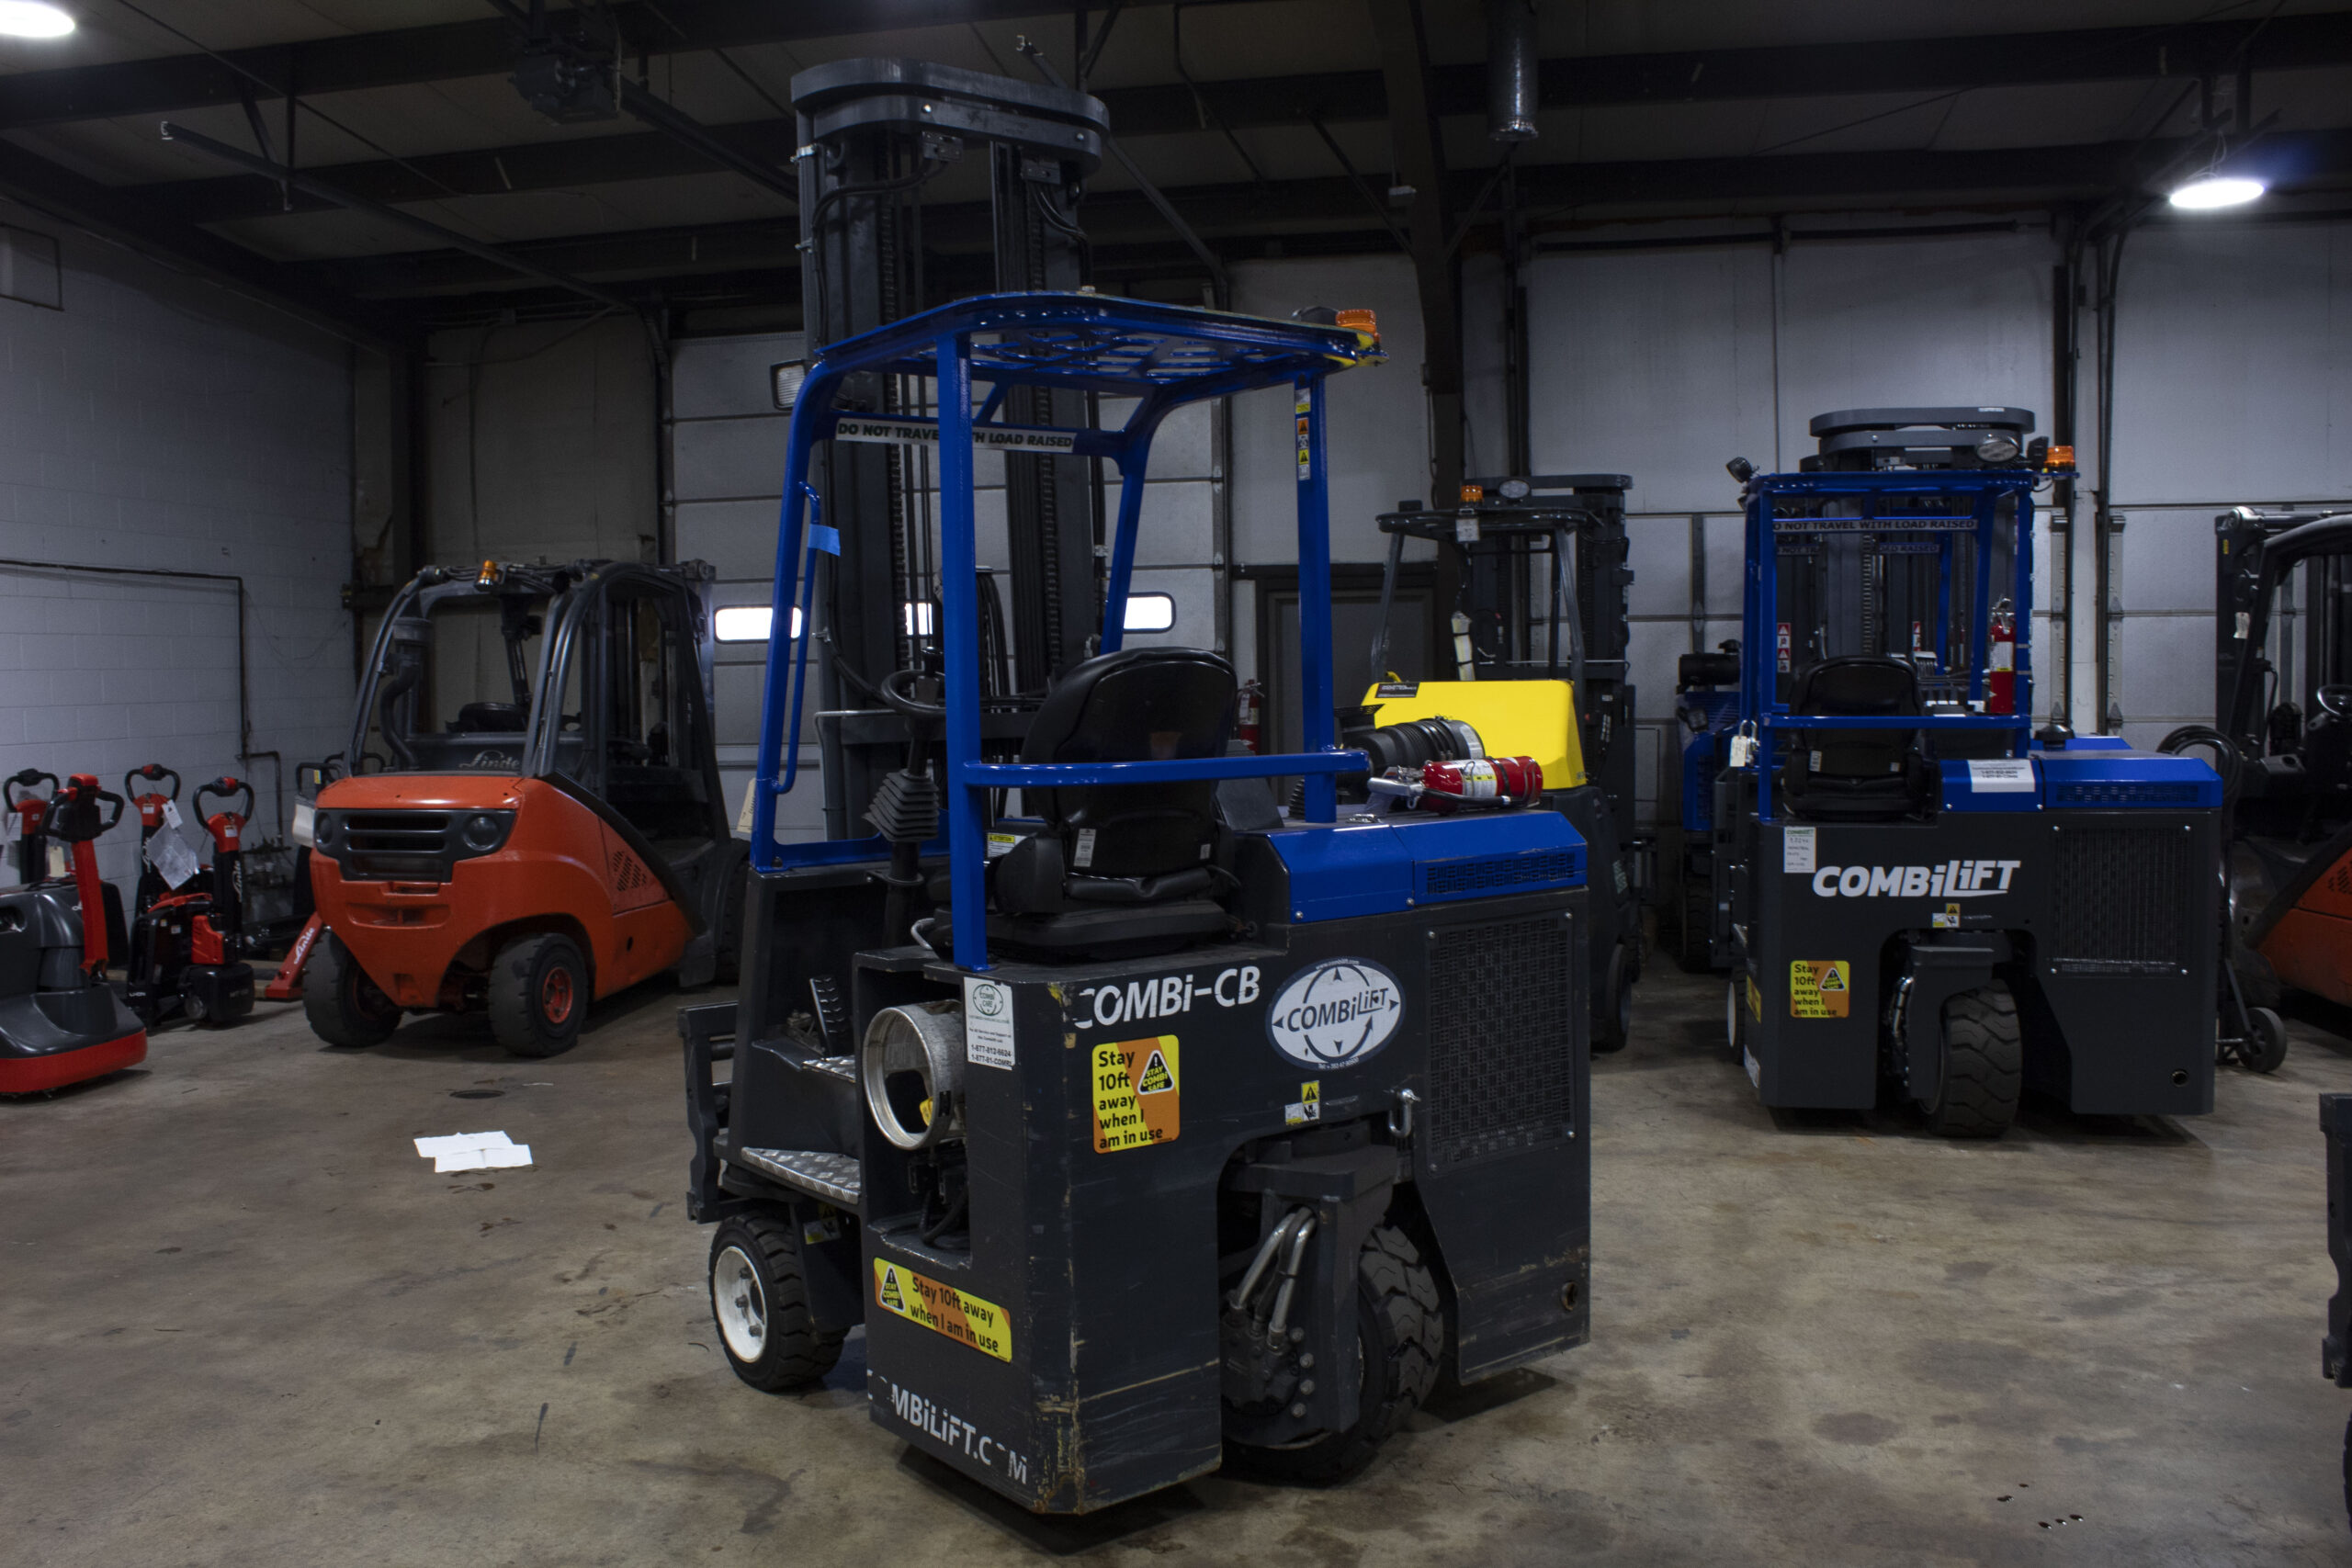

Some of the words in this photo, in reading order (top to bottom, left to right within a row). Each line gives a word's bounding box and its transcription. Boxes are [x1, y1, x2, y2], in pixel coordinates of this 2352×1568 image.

[838, 423, 858, 434] DO
[864, 424, 890, 437] NOT
[896, 426, 939, 440] TRAVE
[989, 433, 1023, 445] LOAD
[1027, 435, 1071, 447] RAISED
[1785, 522, 1807, 530] NOT
[1813, 521, 1855, 530] TRAVEL
[1859, 521, 1891, 529] WITH
[1894, 520, 1926, 529] LOAD
[1930, 520, 1974, 528] RAISED
[459, 750, 520, 768] Linde
[1794, 964, 1820, 976] Stay
[1794, 976, 1815, 986] 10ft
[1794, 988, 1819, 997] away
[1794, 998, 1819, 1006] when
[1099, 1051, 1136, 1068] Stay
[1146, 1066, 1163, 1077] STAY
[1099, 1071, 1130, 1091] 10ft
[1147, 1081, 1166, 1092] SAFE
[1099, 1095, 1136, 1111] away
[1099, 1113, 1136, 1130] when
[1140, 1109, 1144, 1122] I
[1100, 1135, 1120, 1149] am
[1124, 1130, 1136, 1145] in
[1140, 1128, 1163, 1142] use
[912, 1276, 937, 1304] Stay
[939, 1288, 961, 1311] 10ft
[964, 1301, 994, 1328] away
[910, 1303, 939, 1327] when
[947, 1323, 963, 1338] am
[966, 1324, 977, 1344] in
[978, 1334, 999, 1353] use
[866, 1369, 1027, 1484] MBiLiFT.CM
